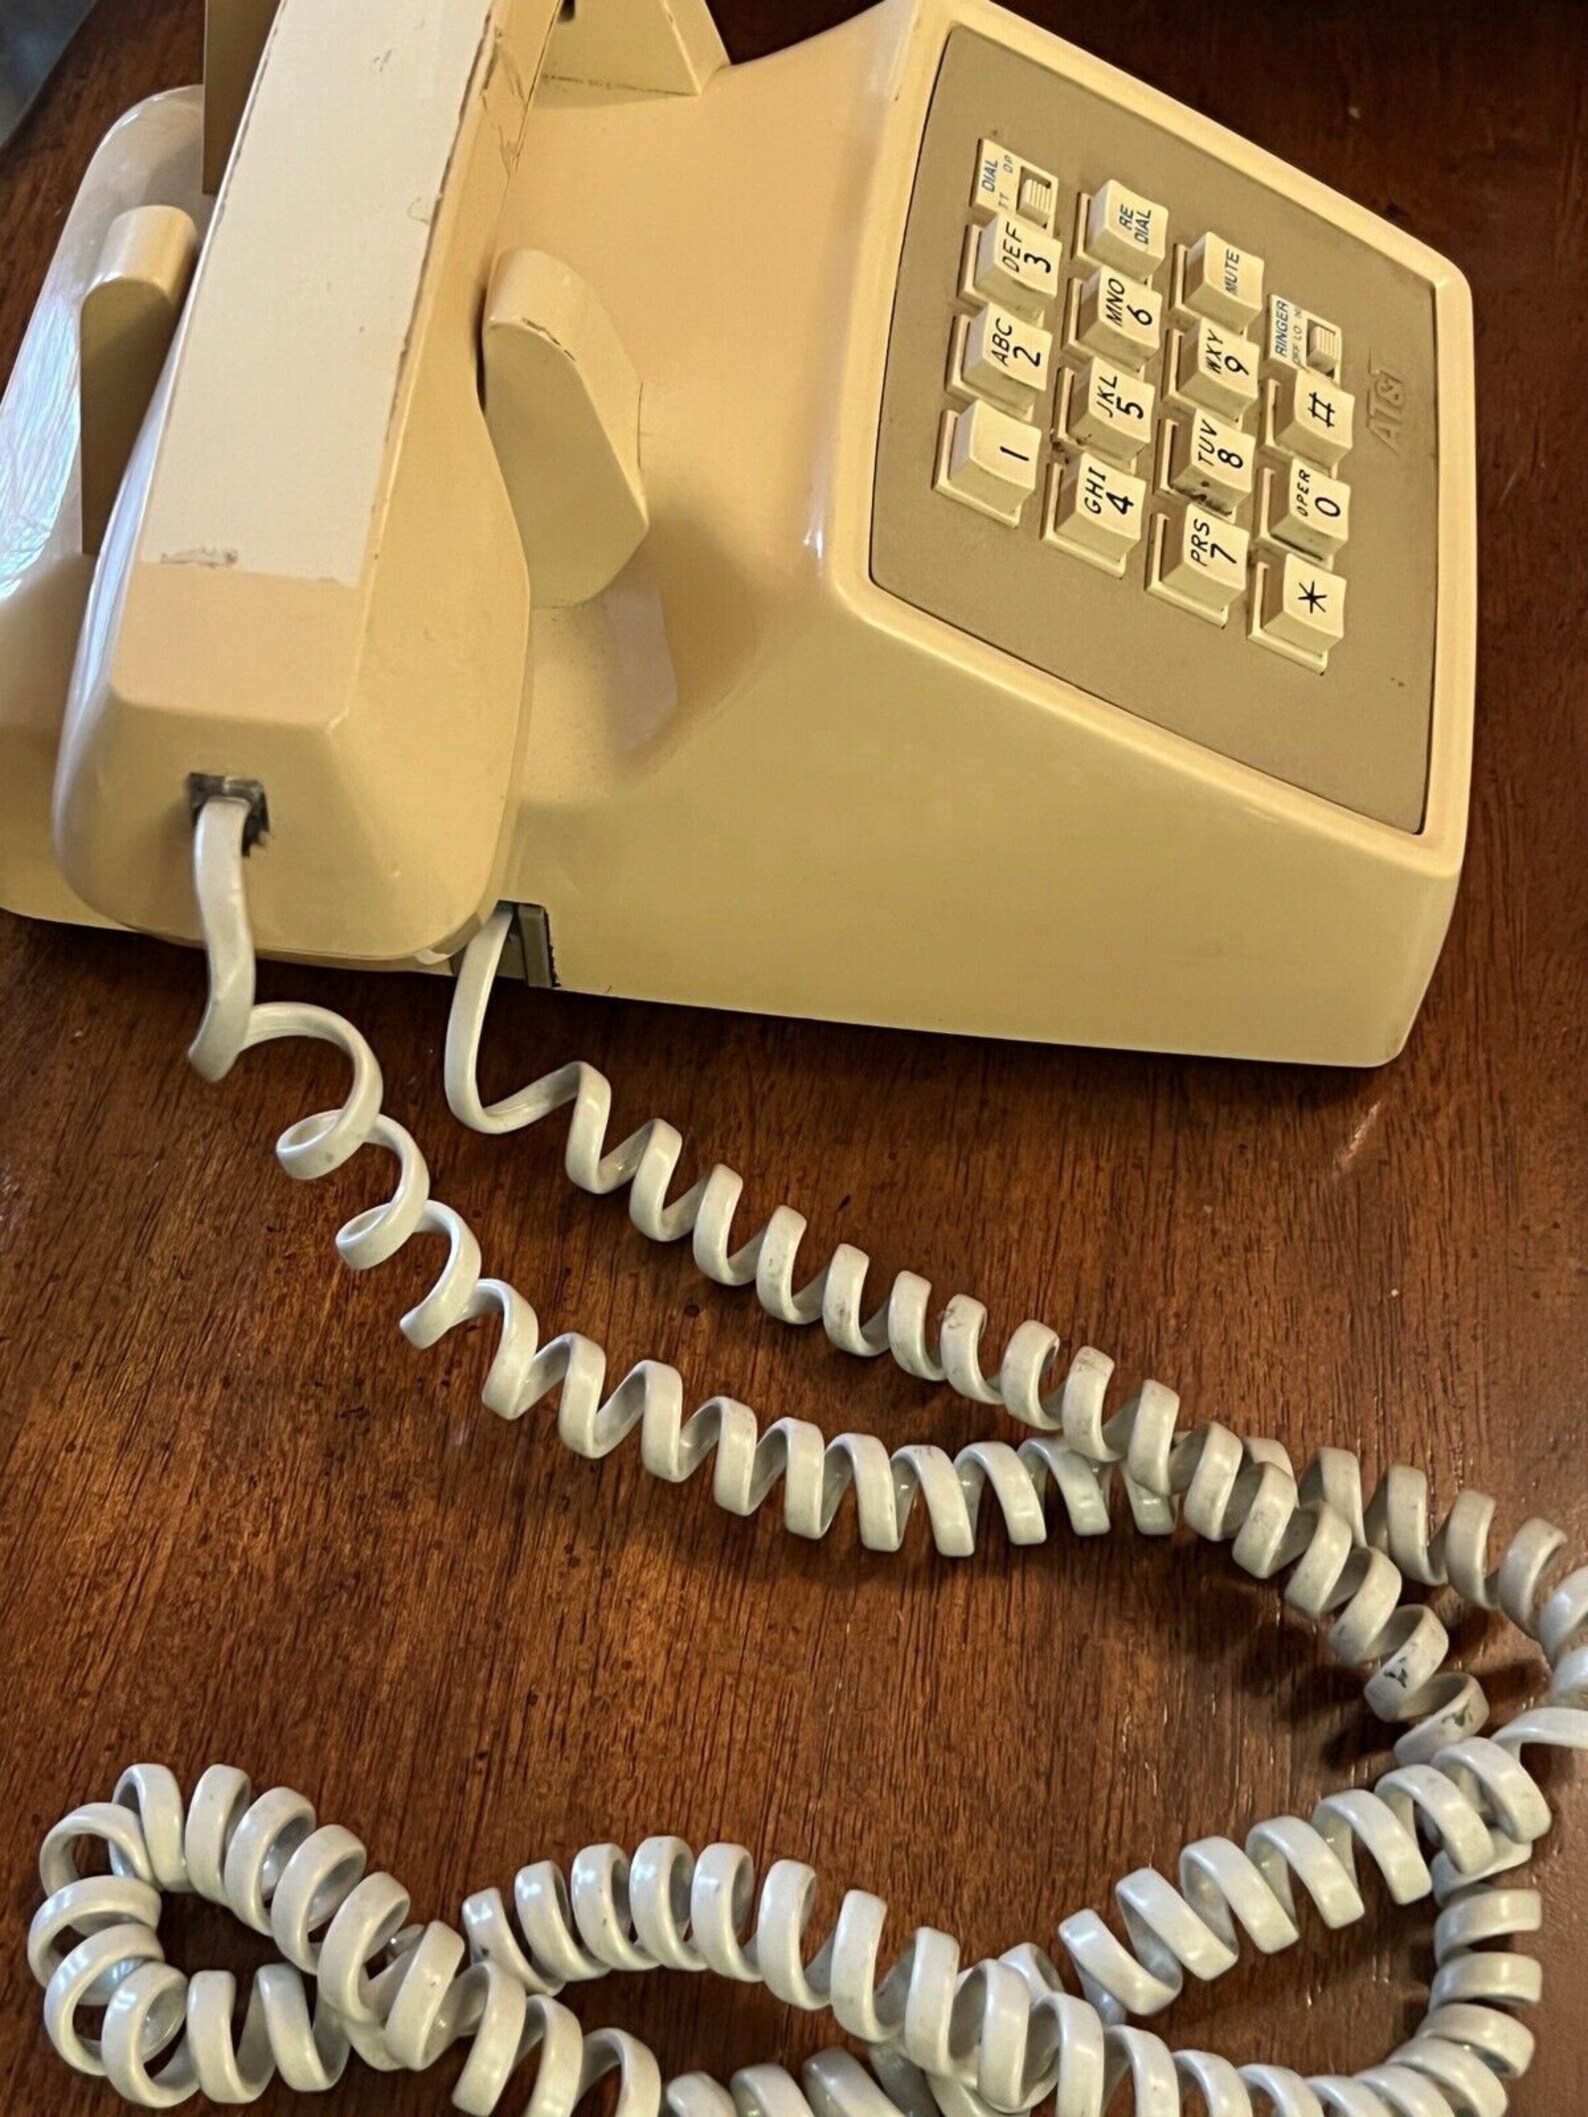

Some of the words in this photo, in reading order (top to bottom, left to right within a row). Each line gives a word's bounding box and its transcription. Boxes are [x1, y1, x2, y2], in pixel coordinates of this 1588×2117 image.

[981, 159, 998, 192] DIAL
[998, 192, 1010, 209] TT
[1119, 205, 1134, 230] RE
[1134, 209, 1152, 245] DIAL
[1002, 221, 1023, 273] DEF
[1023, 252, 1051, 274] 3
[1225, 249, 1240, 296] MUTE
[1105, 278, 1126, 327] MNO
[1126, 305, 1153, 326] 6
[991, 317, 1013, 366] ABC
[1275, 300, 1289, 358] RINGER
[1294, 325, 1302, 341] LO
[1013, 346, 1041, 368] 2
[1206, 329, 1224, 375] WXY
[1224, 355, 1249, 377] 9
[1096, 375, 1118, 418] JKL
[1116, 397, 1144, 420] 5
[1308, 391, 1335, 428] #
[1367, 349, 1406, 455] AT&T
[999, 445, 1030, 462] 1
[1198, 419, 1218, 468] TUV
[1216, 448, 1244, 469] 8
[1083, 466, 1107, 515] GHI
[1106, 491, 1134, 515] 4
[1297, 468, 1311, 517] OPER
[1315, 496, 1341, 517] 0
[1191, 518, 1210, 566] PRS
[1210, 543, 1237, 564] 7
